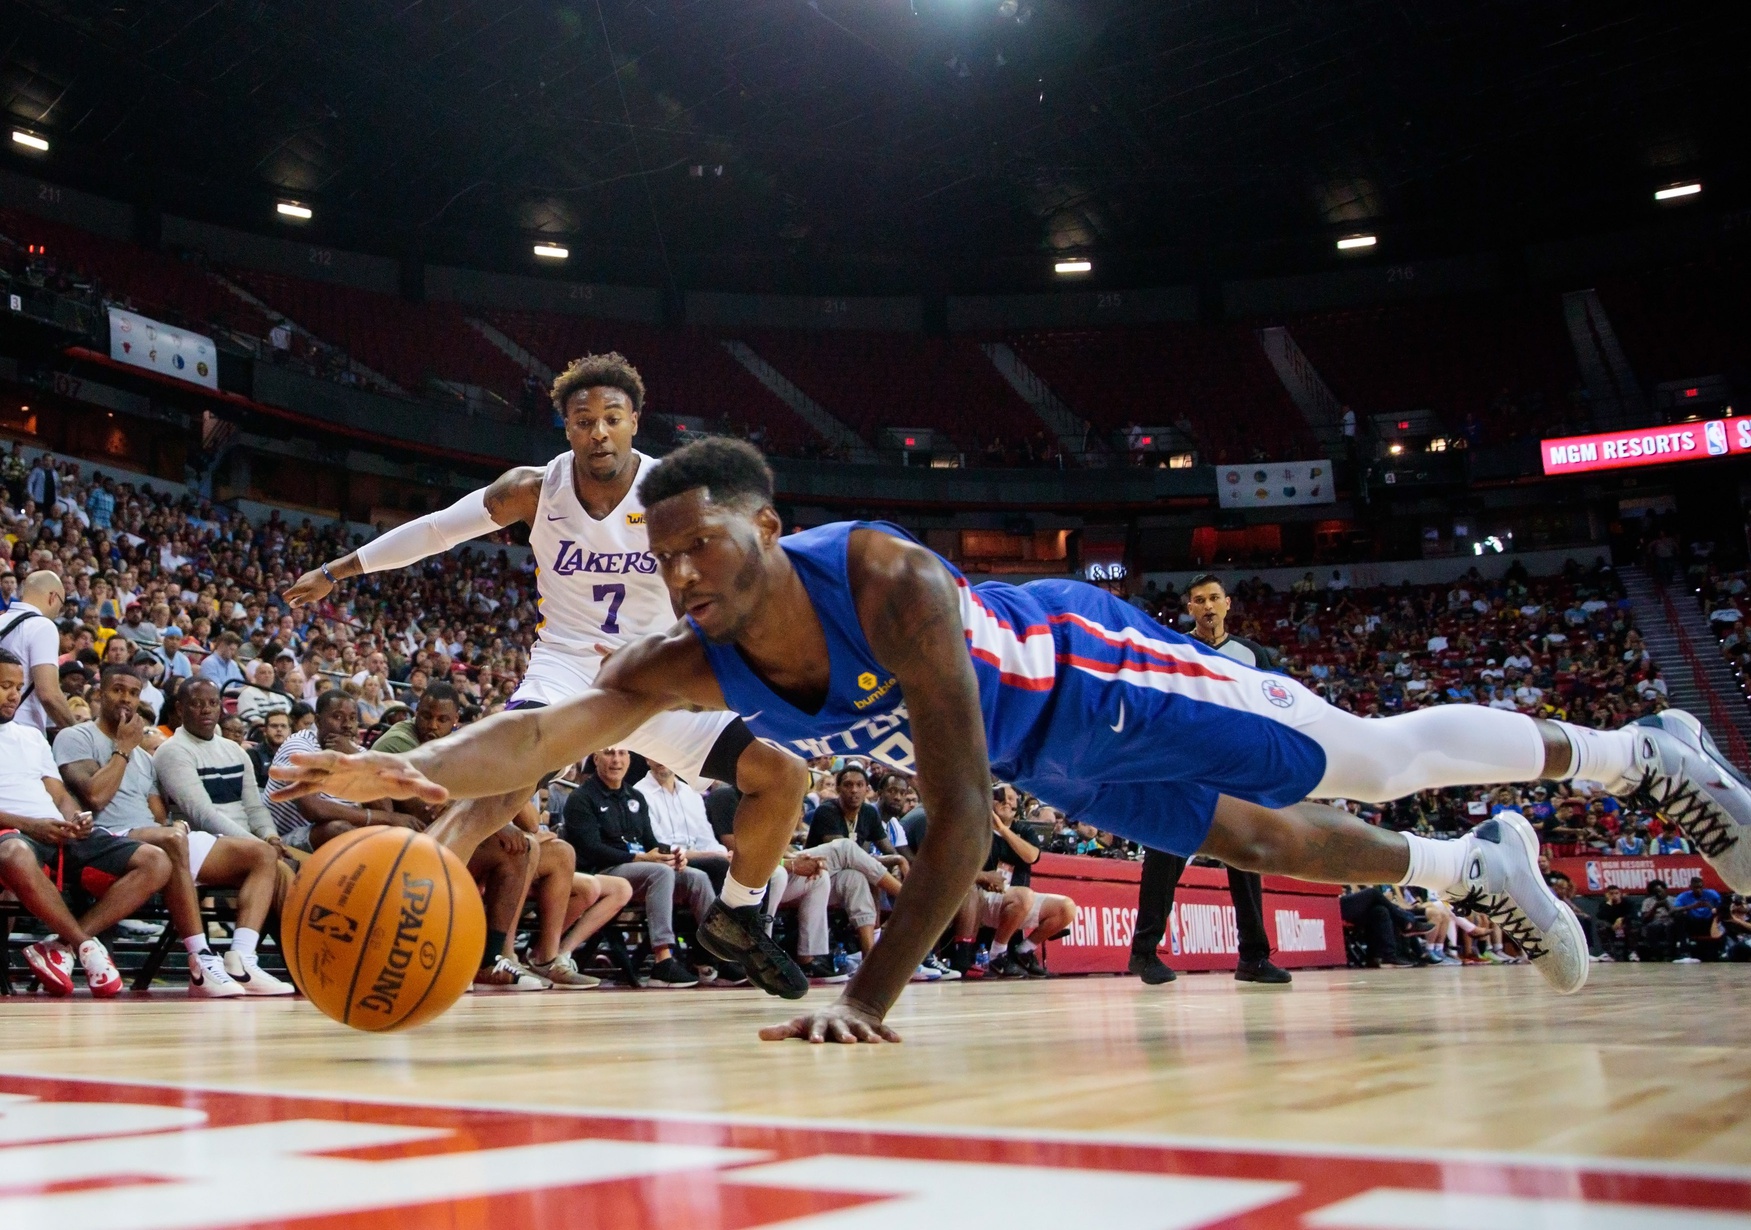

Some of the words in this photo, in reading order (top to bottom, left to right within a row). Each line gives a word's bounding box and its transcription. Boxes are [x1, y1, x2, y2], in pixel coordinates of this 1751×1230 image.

[39, 184, 61, 203] 211
[1550, 443, 1598, 465] MGM
[1602, 431, 1696, 460] RESORTS
[552, 540, 657, 576] LAKERS
[593, 583, 626, 634] 7
[356, 871, 434, 1015] SPALDING
[1180, 903, 1225, 954] SUMMER
